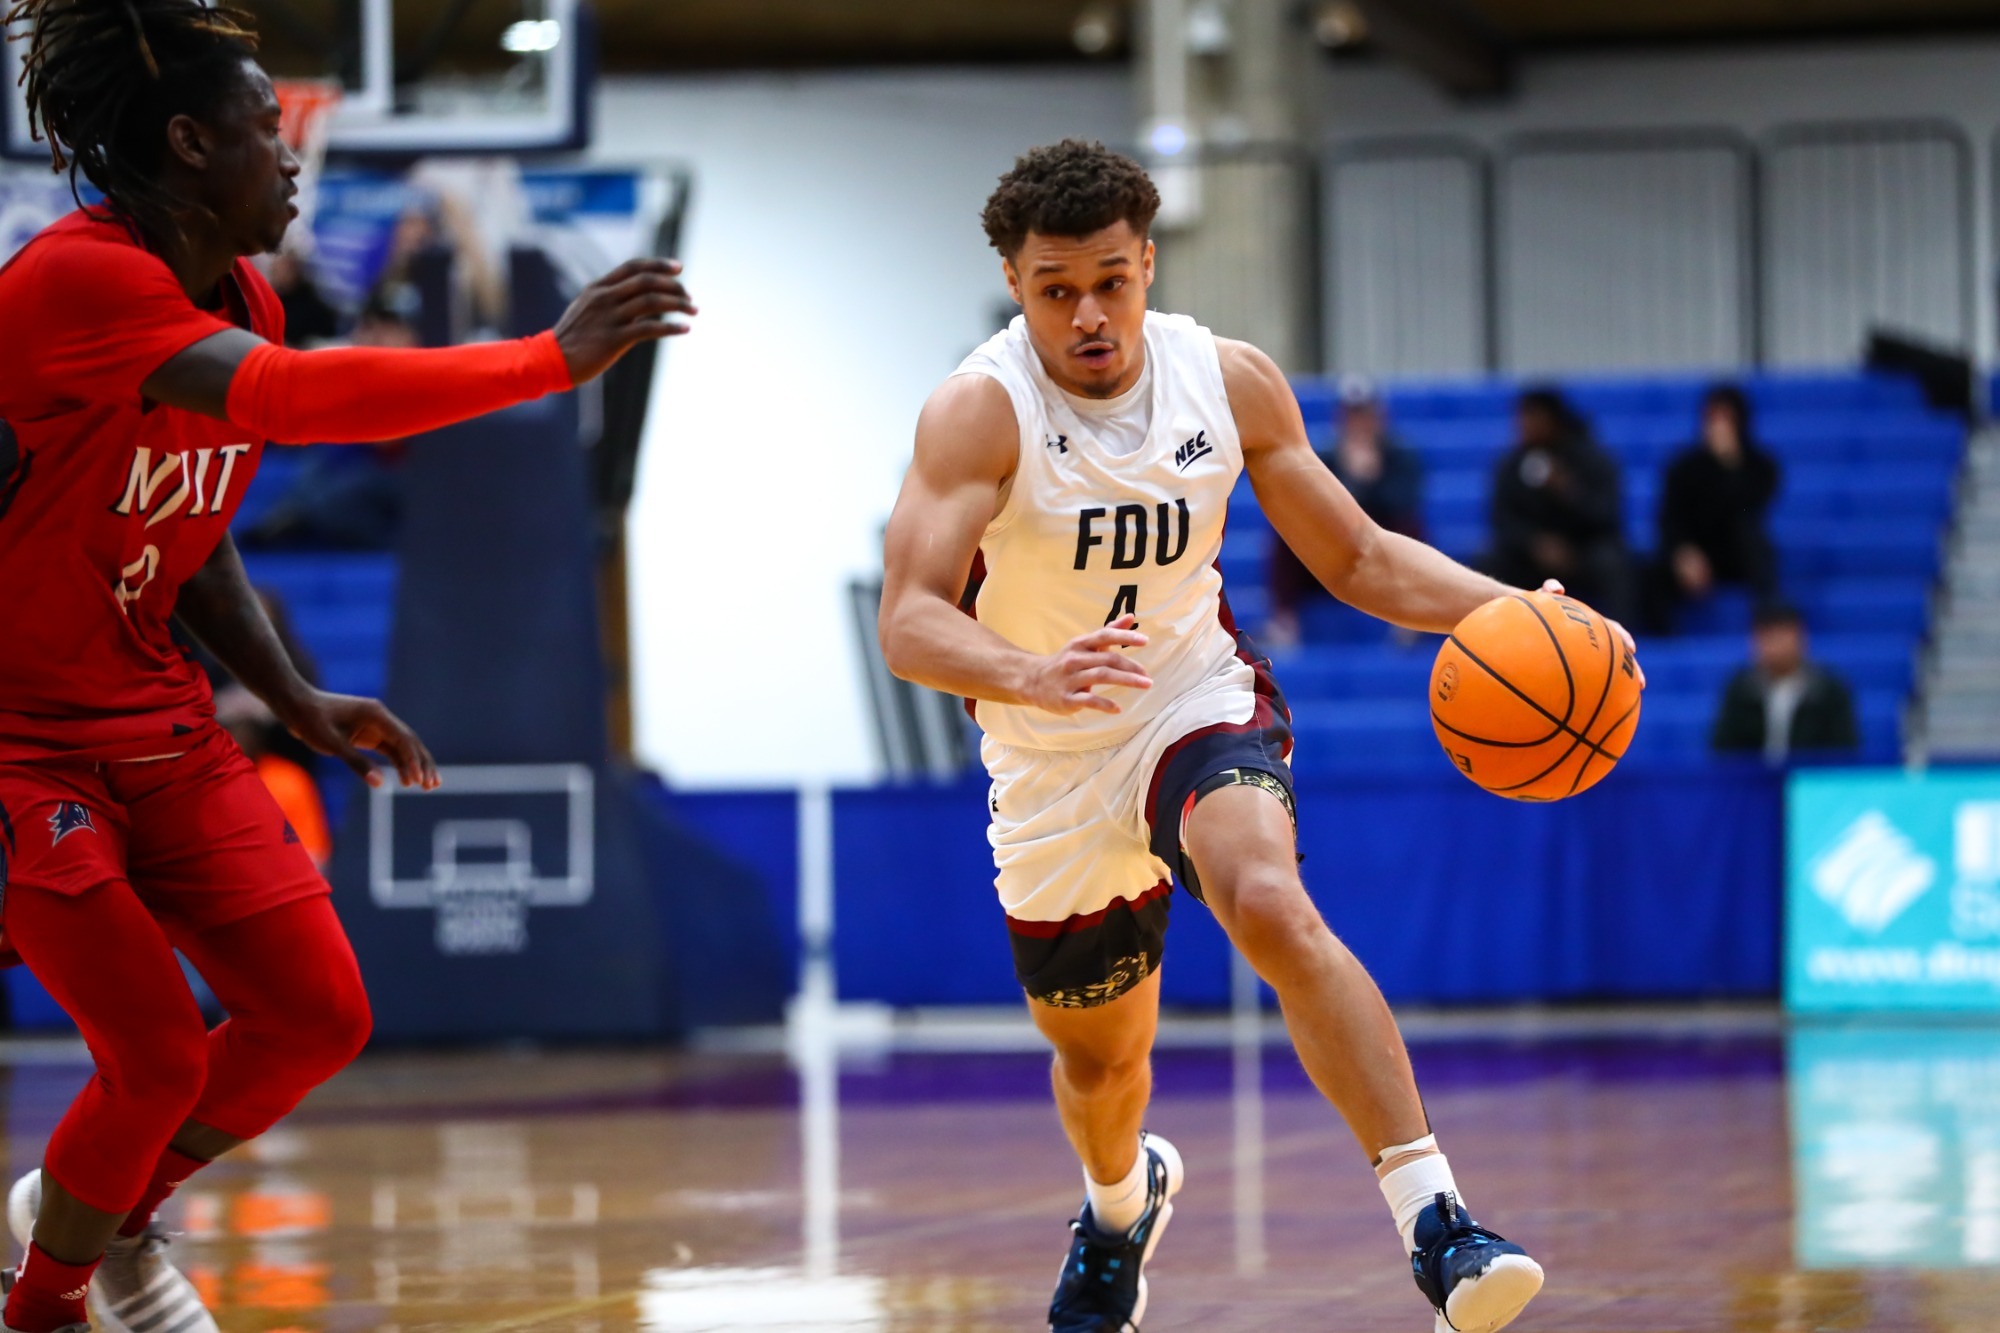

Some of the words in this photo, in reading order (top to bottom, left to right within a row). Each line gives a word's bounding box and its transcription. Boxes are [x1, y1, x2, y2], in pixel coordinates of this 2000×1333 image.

[1175, 430, 1206, 467] NEC
[108, 443, 252, 531] NJIT
[1073, 498, 1190, 571] FDU
[1104, 584, 1139, 649] 4
